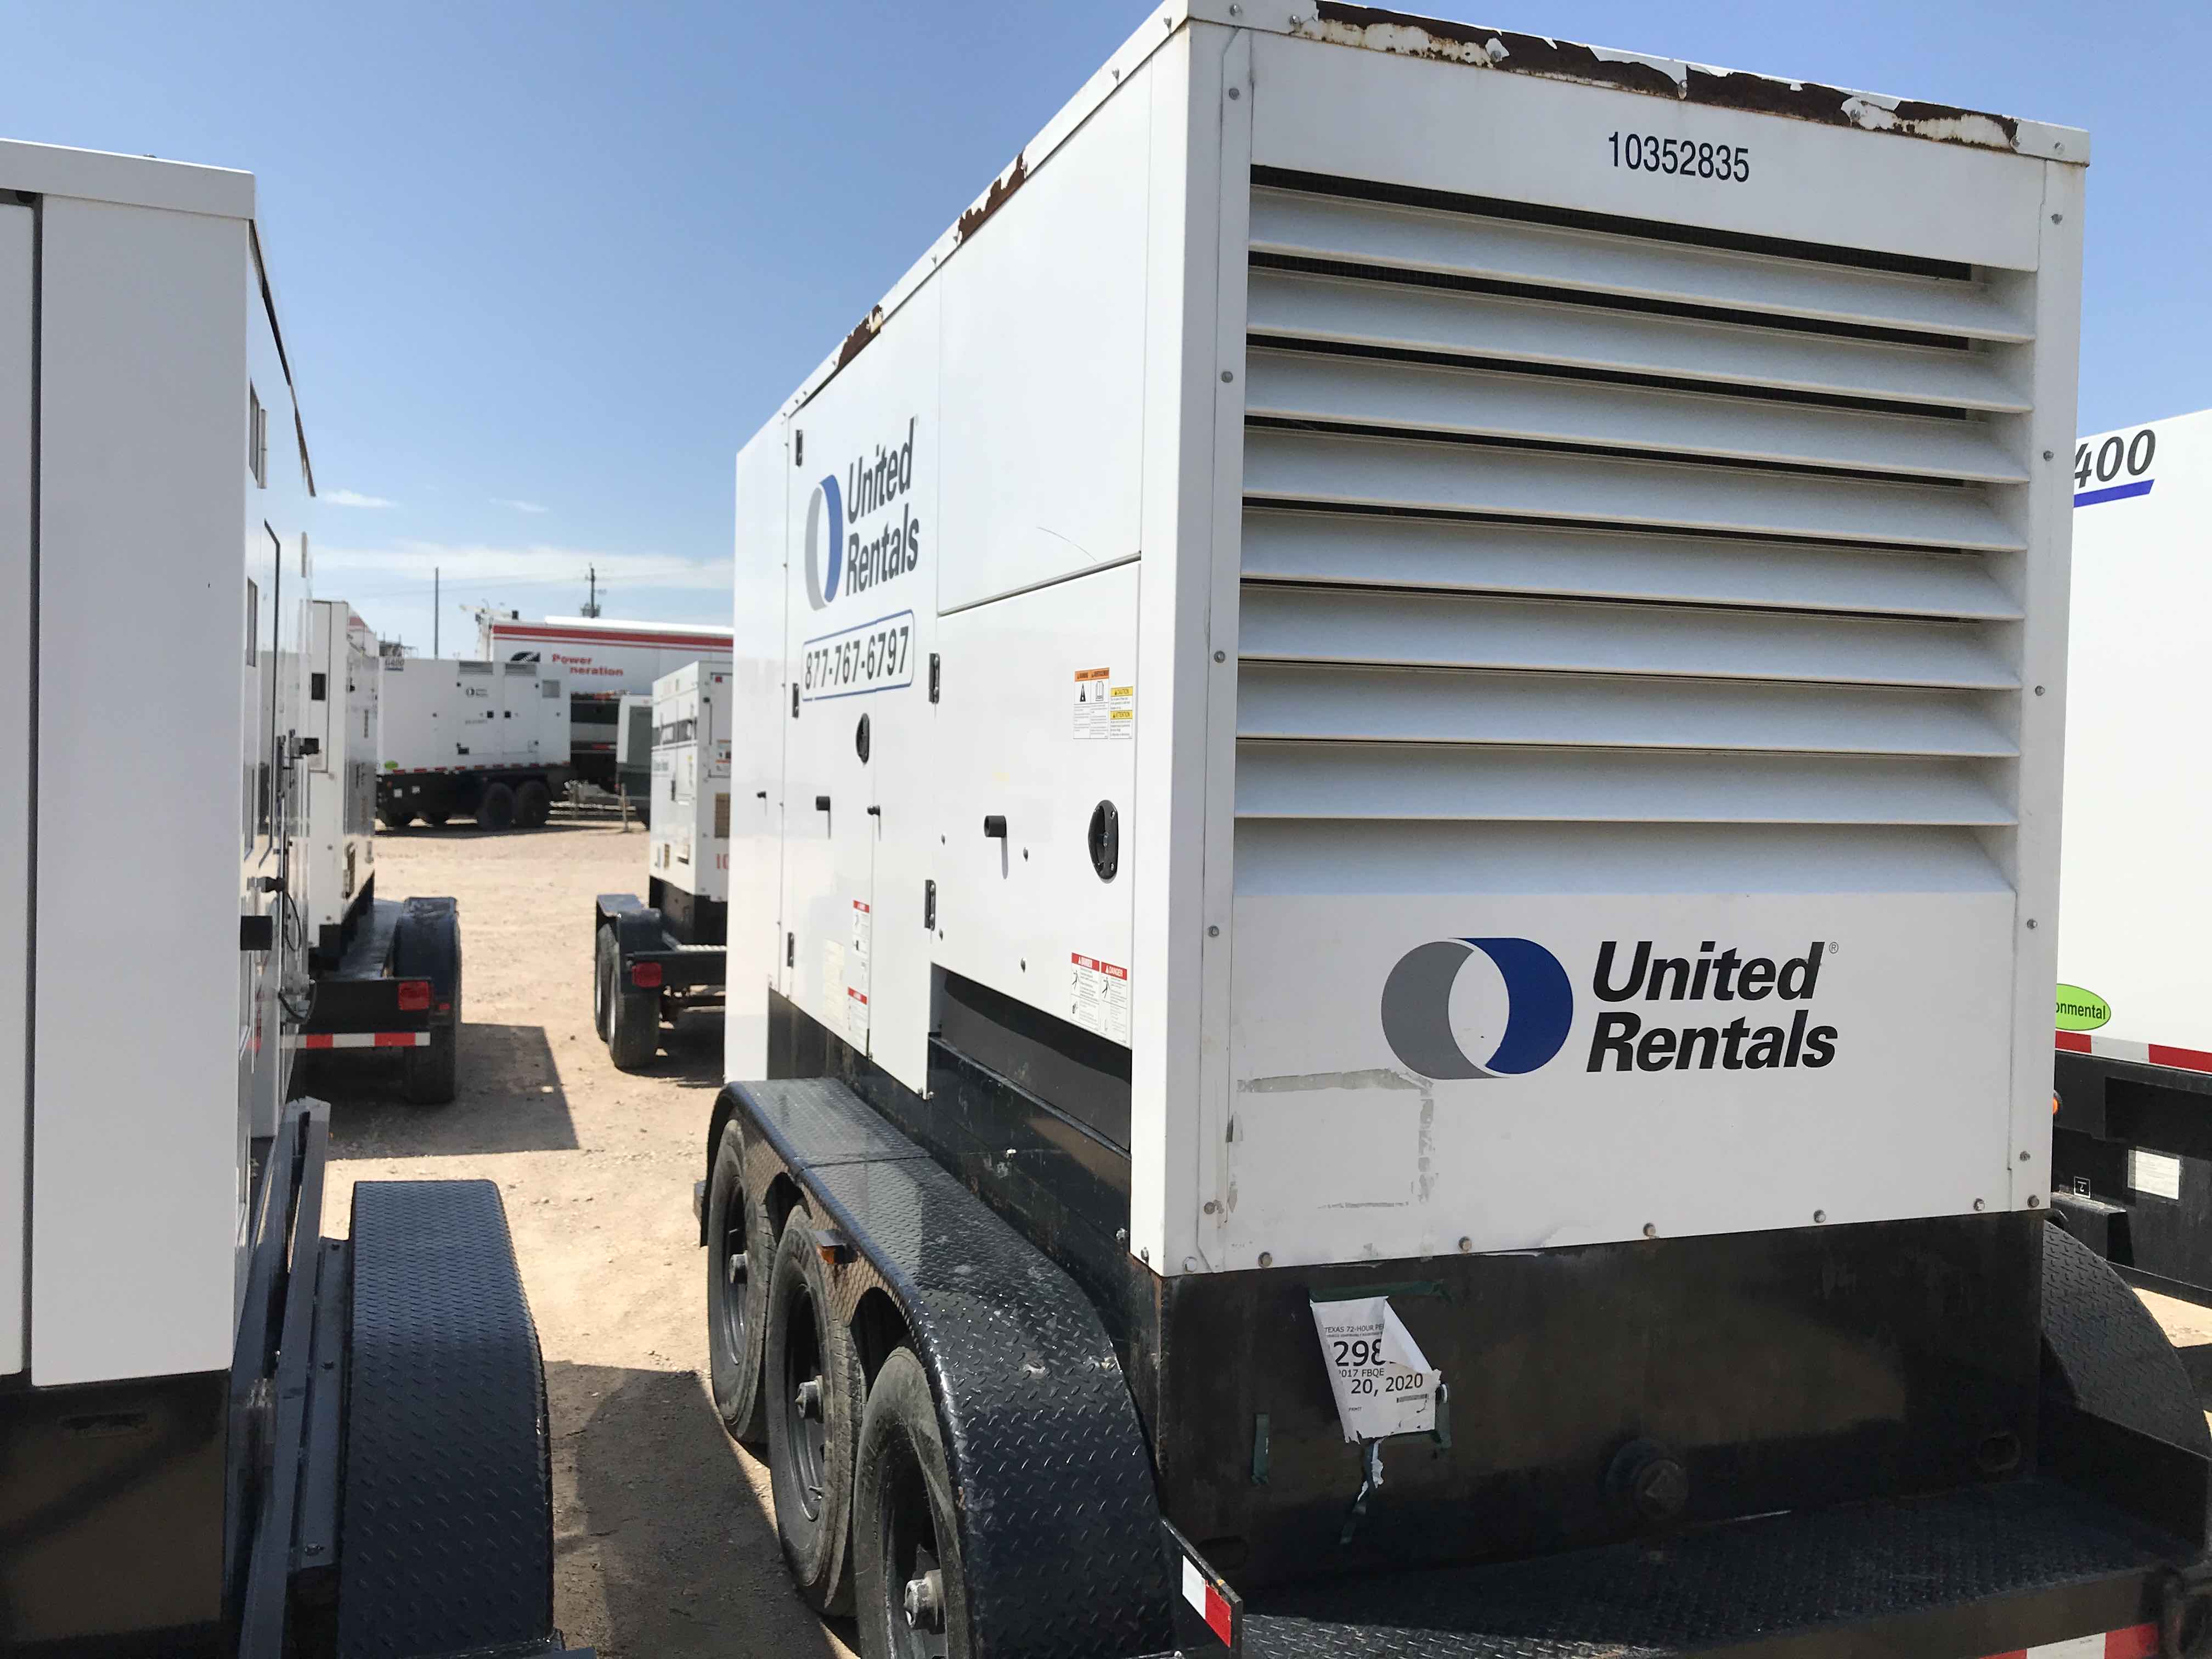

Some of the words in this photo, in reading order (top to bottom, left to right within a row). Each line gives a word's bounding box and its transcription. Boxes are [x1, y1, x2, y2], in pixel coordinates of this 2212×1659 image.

[1609, 131, 1750, 183] 10352835
[848, 417, 915, 524] United
[2074, 429, 2156, 489] 400
[845, 503, 919, 596] Rentals
[552, 653, 593, 665] Power
[570, 666, 624, 676] neration
[805, 626, 909, 690] 877-767-6797
[1593, 941, 1826, 1002] United
[1586, 1009, 1838, 1072] Rentals
[1333, 1338, 1396, 1367] 298
[1339, 1369, 1358, 1378] 017
[1362, 1368, 1385, 1378] FBQE
[1351, 1379, 1379, 1397] 20,
[1385, 1373, 1424, 1393] 2020
